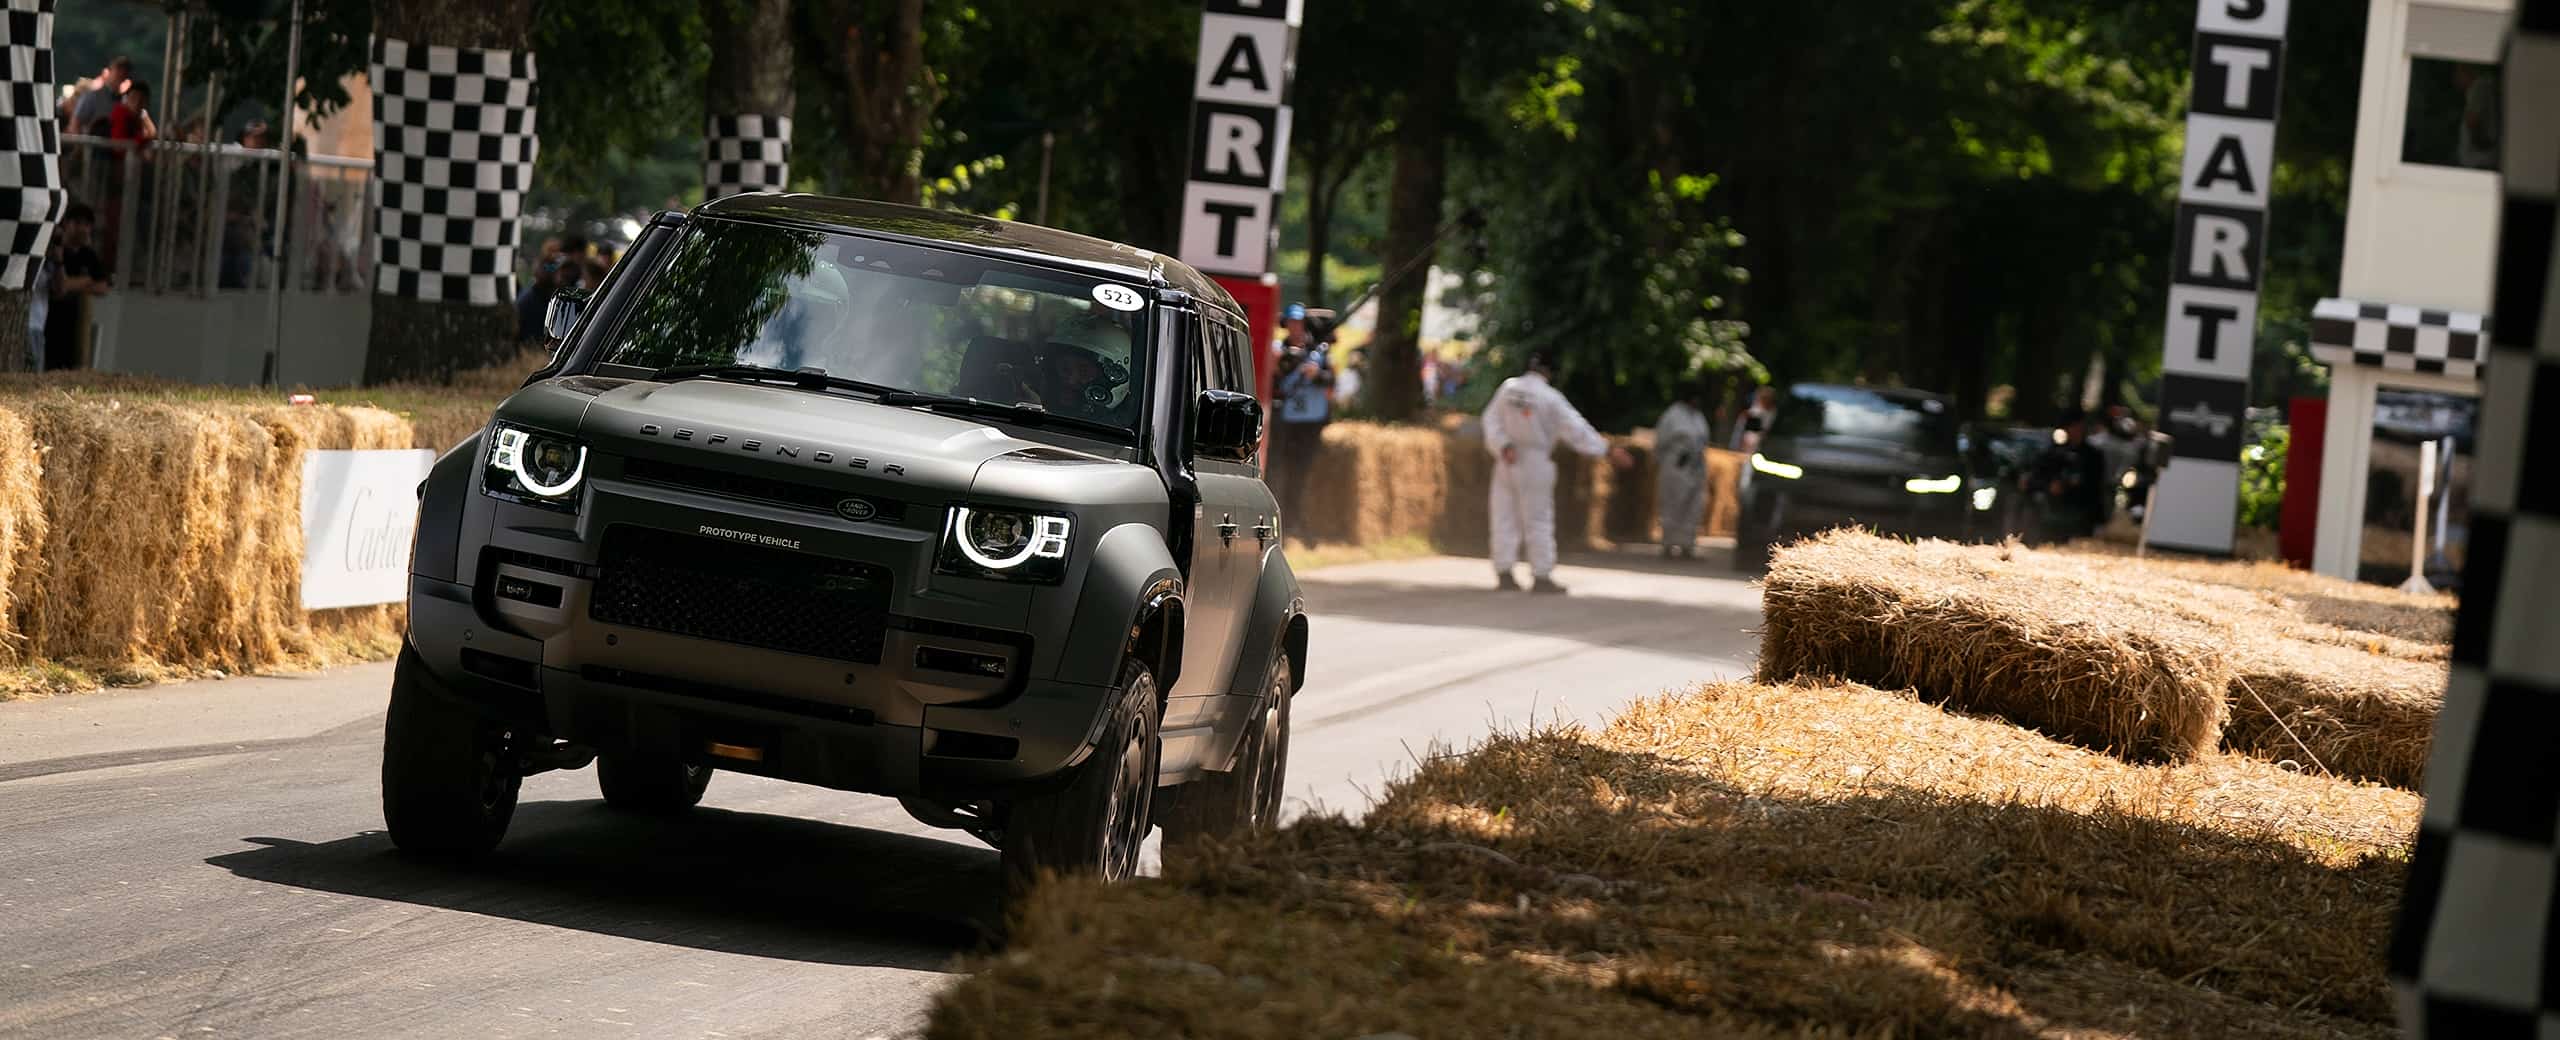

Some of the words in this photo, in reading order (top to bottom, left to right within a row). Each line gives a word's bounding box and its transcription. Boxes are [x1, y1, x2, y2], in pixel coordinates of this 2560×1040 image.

[1203, 0, 1269, 257] ART
[1104, 289, 1132, 305] 523
[640, 423, 905, 476] DEFENDER
[699, 525, 758, 542] PROTOTYPE
[759, 535, 801, 549] VEHICLE
